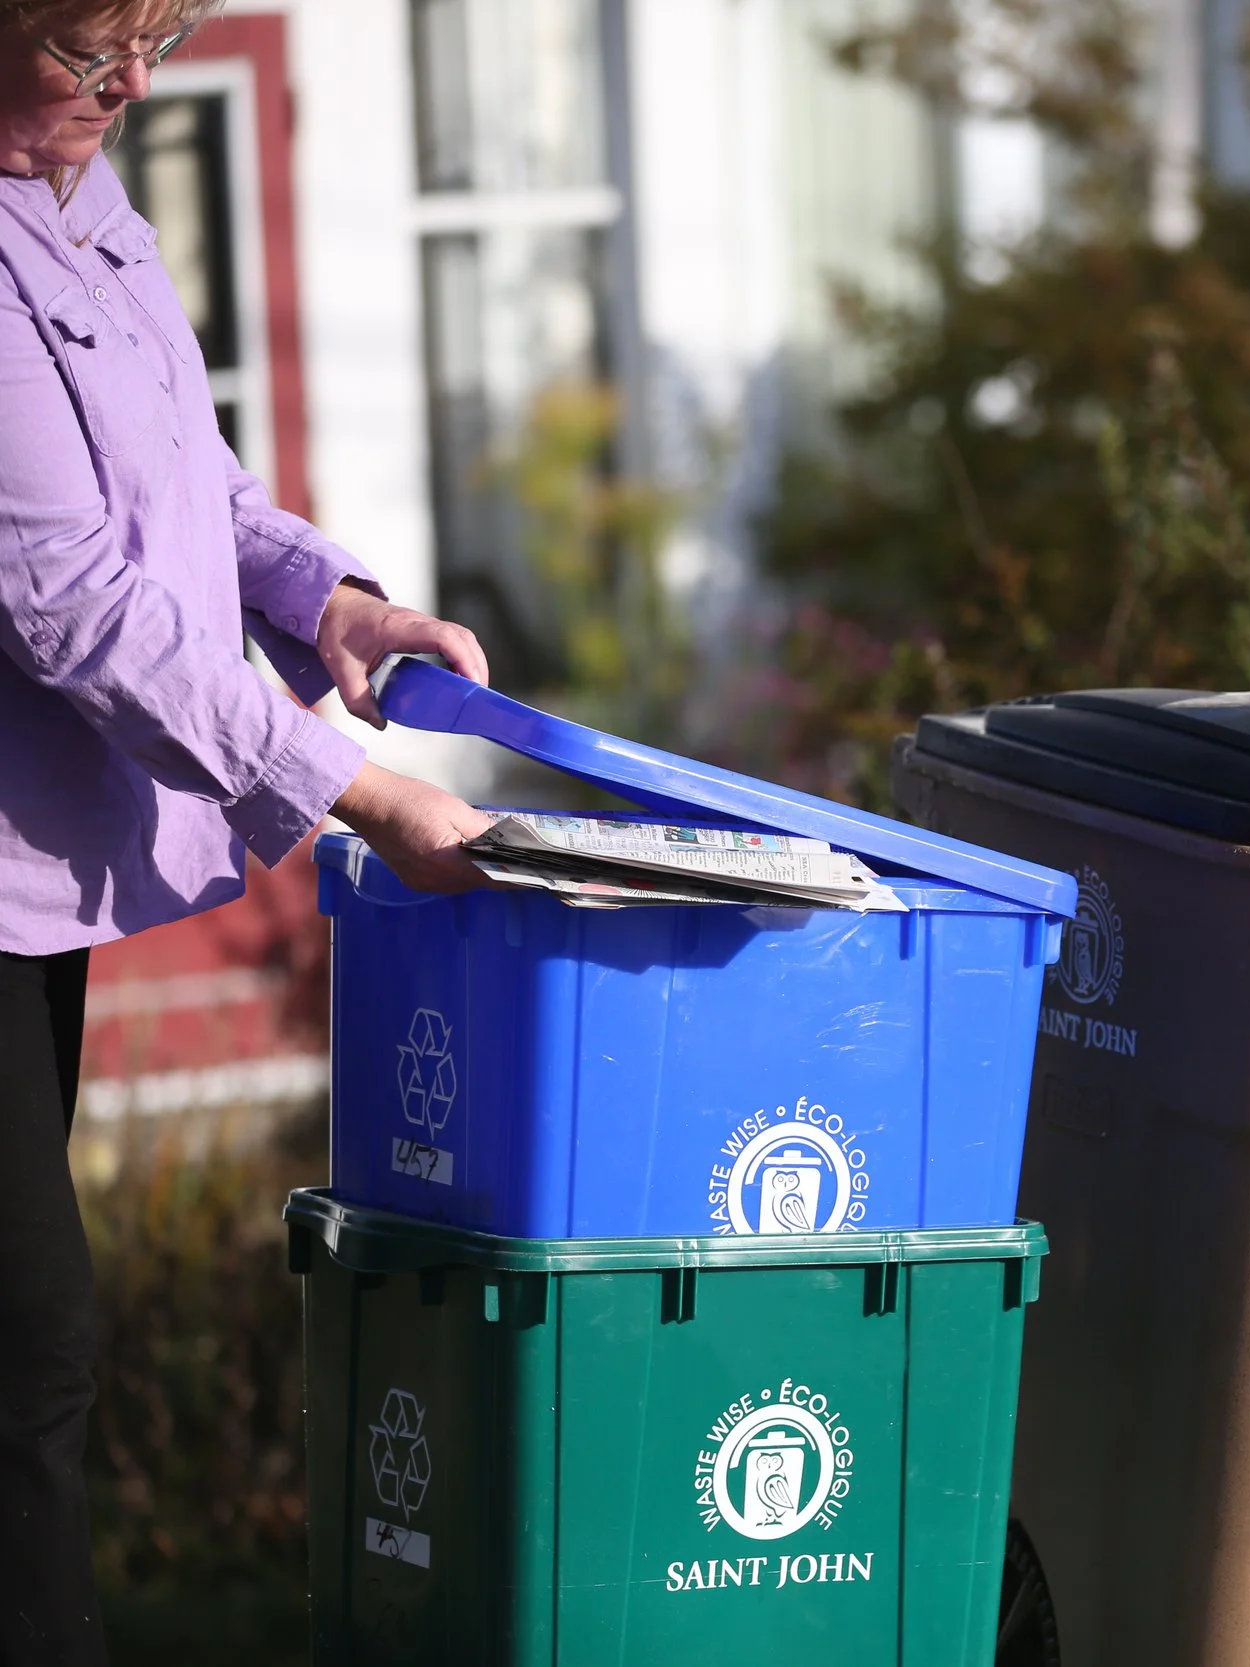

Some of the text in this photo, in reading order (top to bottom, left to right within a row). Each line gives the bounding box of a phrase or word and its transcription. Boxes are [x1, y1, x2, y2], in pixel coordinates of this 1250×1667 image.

[1038, 1005, 1137, 1057] AINT JOHN
[720, 1109, 770, 1158] WISE
[397, 1139, 439, 1183] 457
[694, 1377, 854, 1533] WASTE WISE ÉCO-LOGIQUE
[666, 1552, 875, 1592] SAINT JOHN
